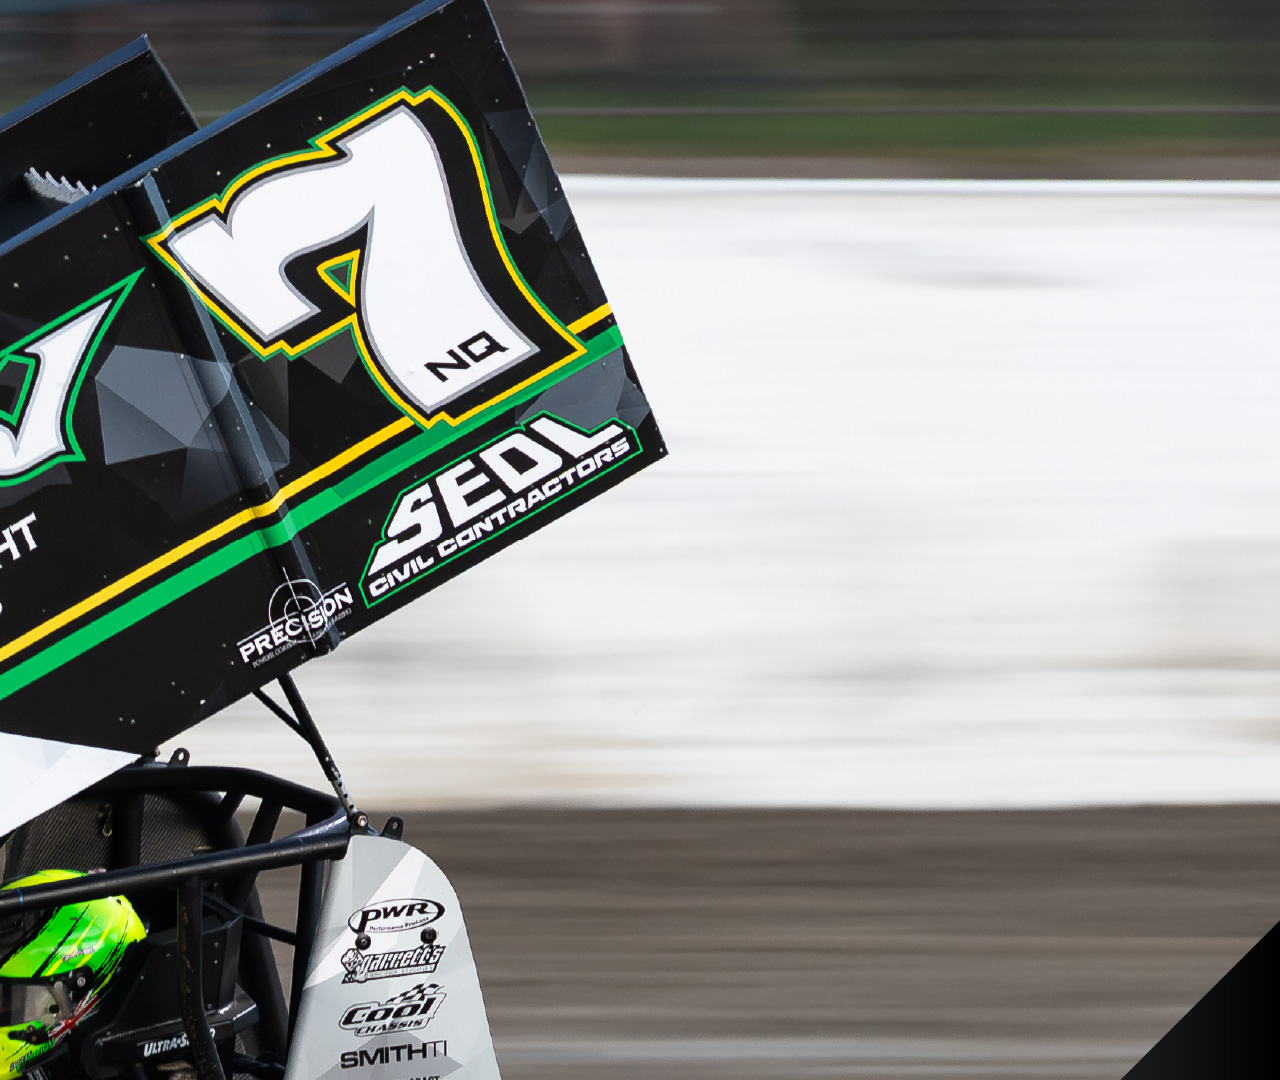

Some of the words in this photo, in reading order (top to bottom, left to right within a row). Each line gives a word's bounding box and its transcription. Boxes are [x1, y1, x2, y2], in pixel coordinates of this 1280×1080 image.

[158, 98, 555, 420] 7
[424, 330, 509, 382] NQ
[369, 556, 435, 598] CIVIL
[437, 436, 630, 561] CONTRACTORS
[239, 586, 354, 664] PRECISION
